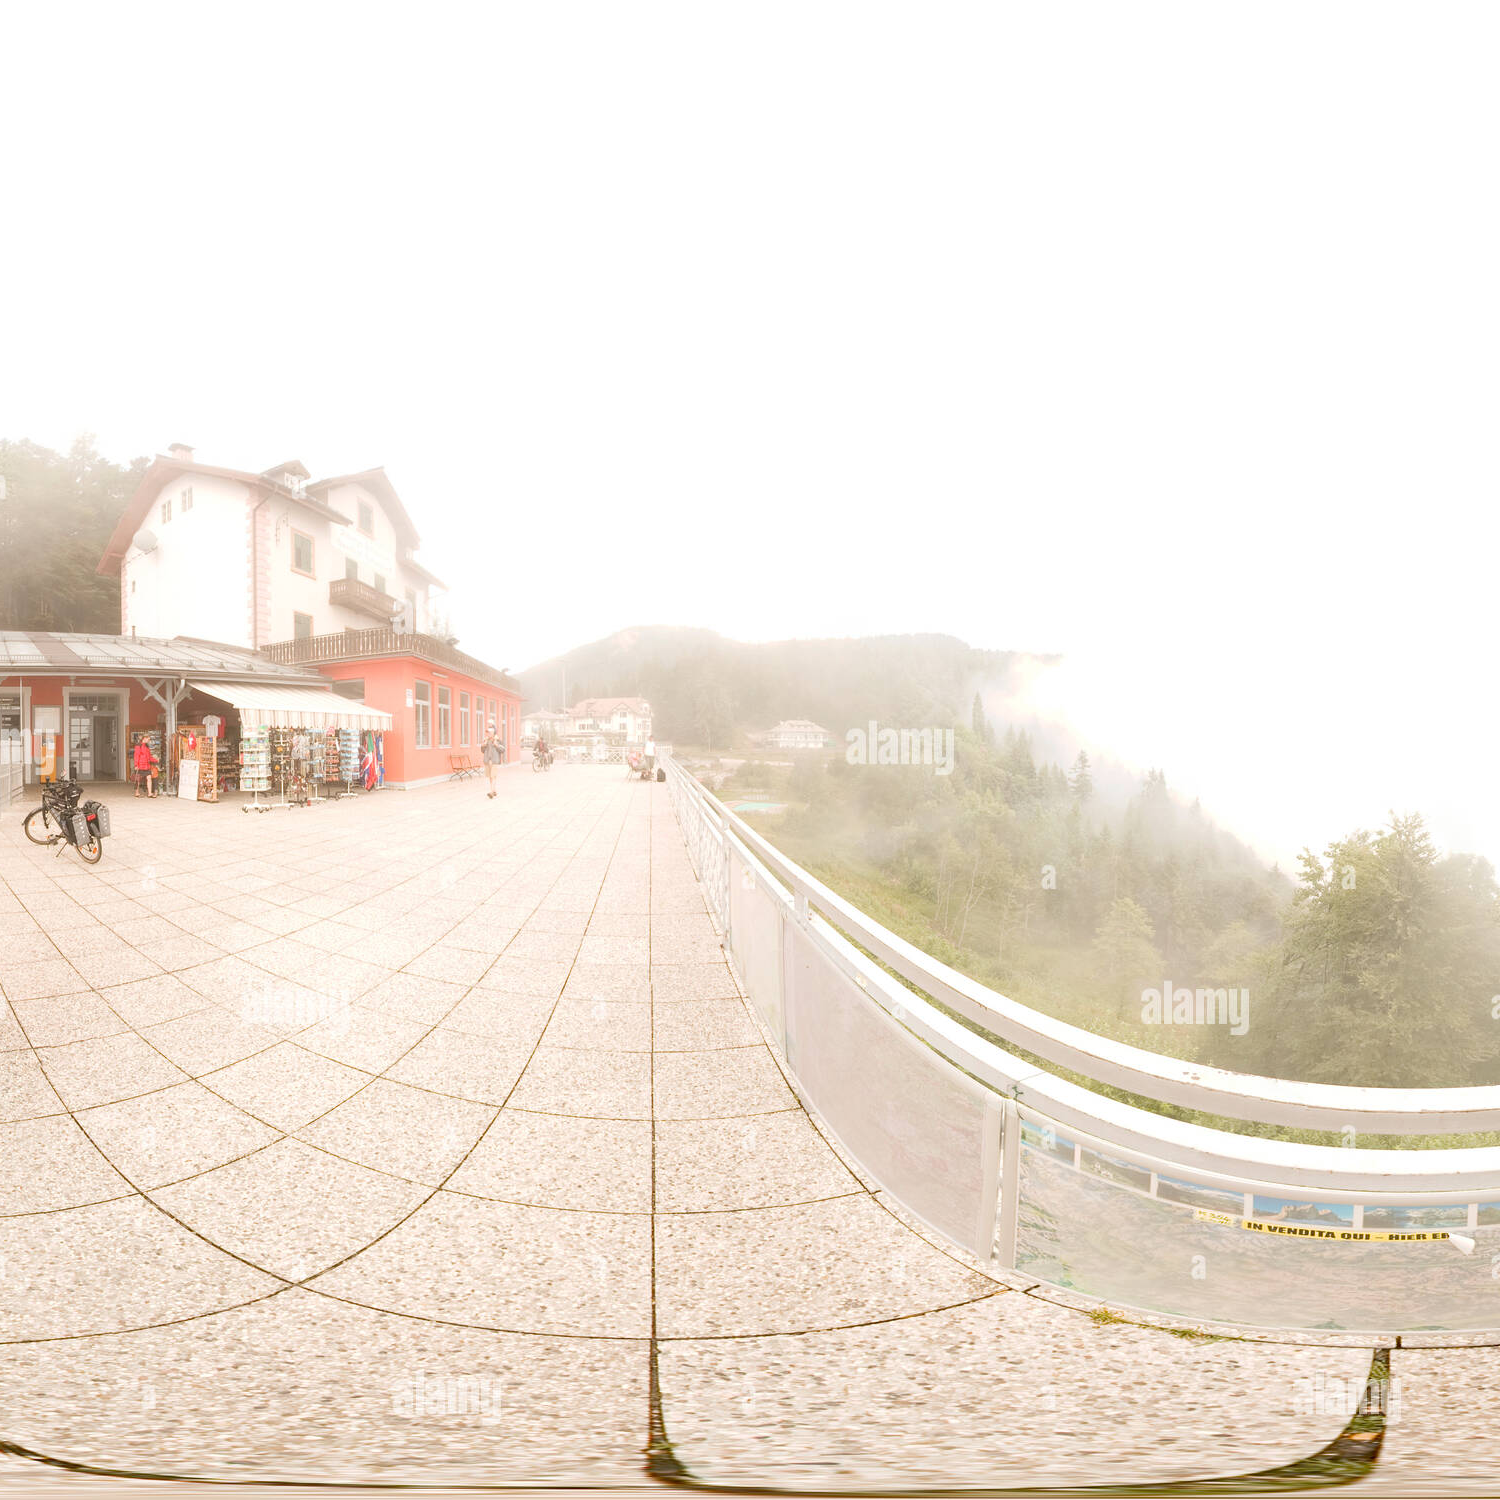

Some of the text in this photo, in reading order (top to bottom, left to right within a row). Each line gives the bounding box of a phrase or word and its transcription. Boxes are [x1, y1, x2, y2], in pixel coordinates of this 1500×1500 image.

[1247, 1222, 1263, 1231] IN
[1267, 1225, 1336, 1239] VENDITA
[1388, 1233, 1427, 1241] HIER
